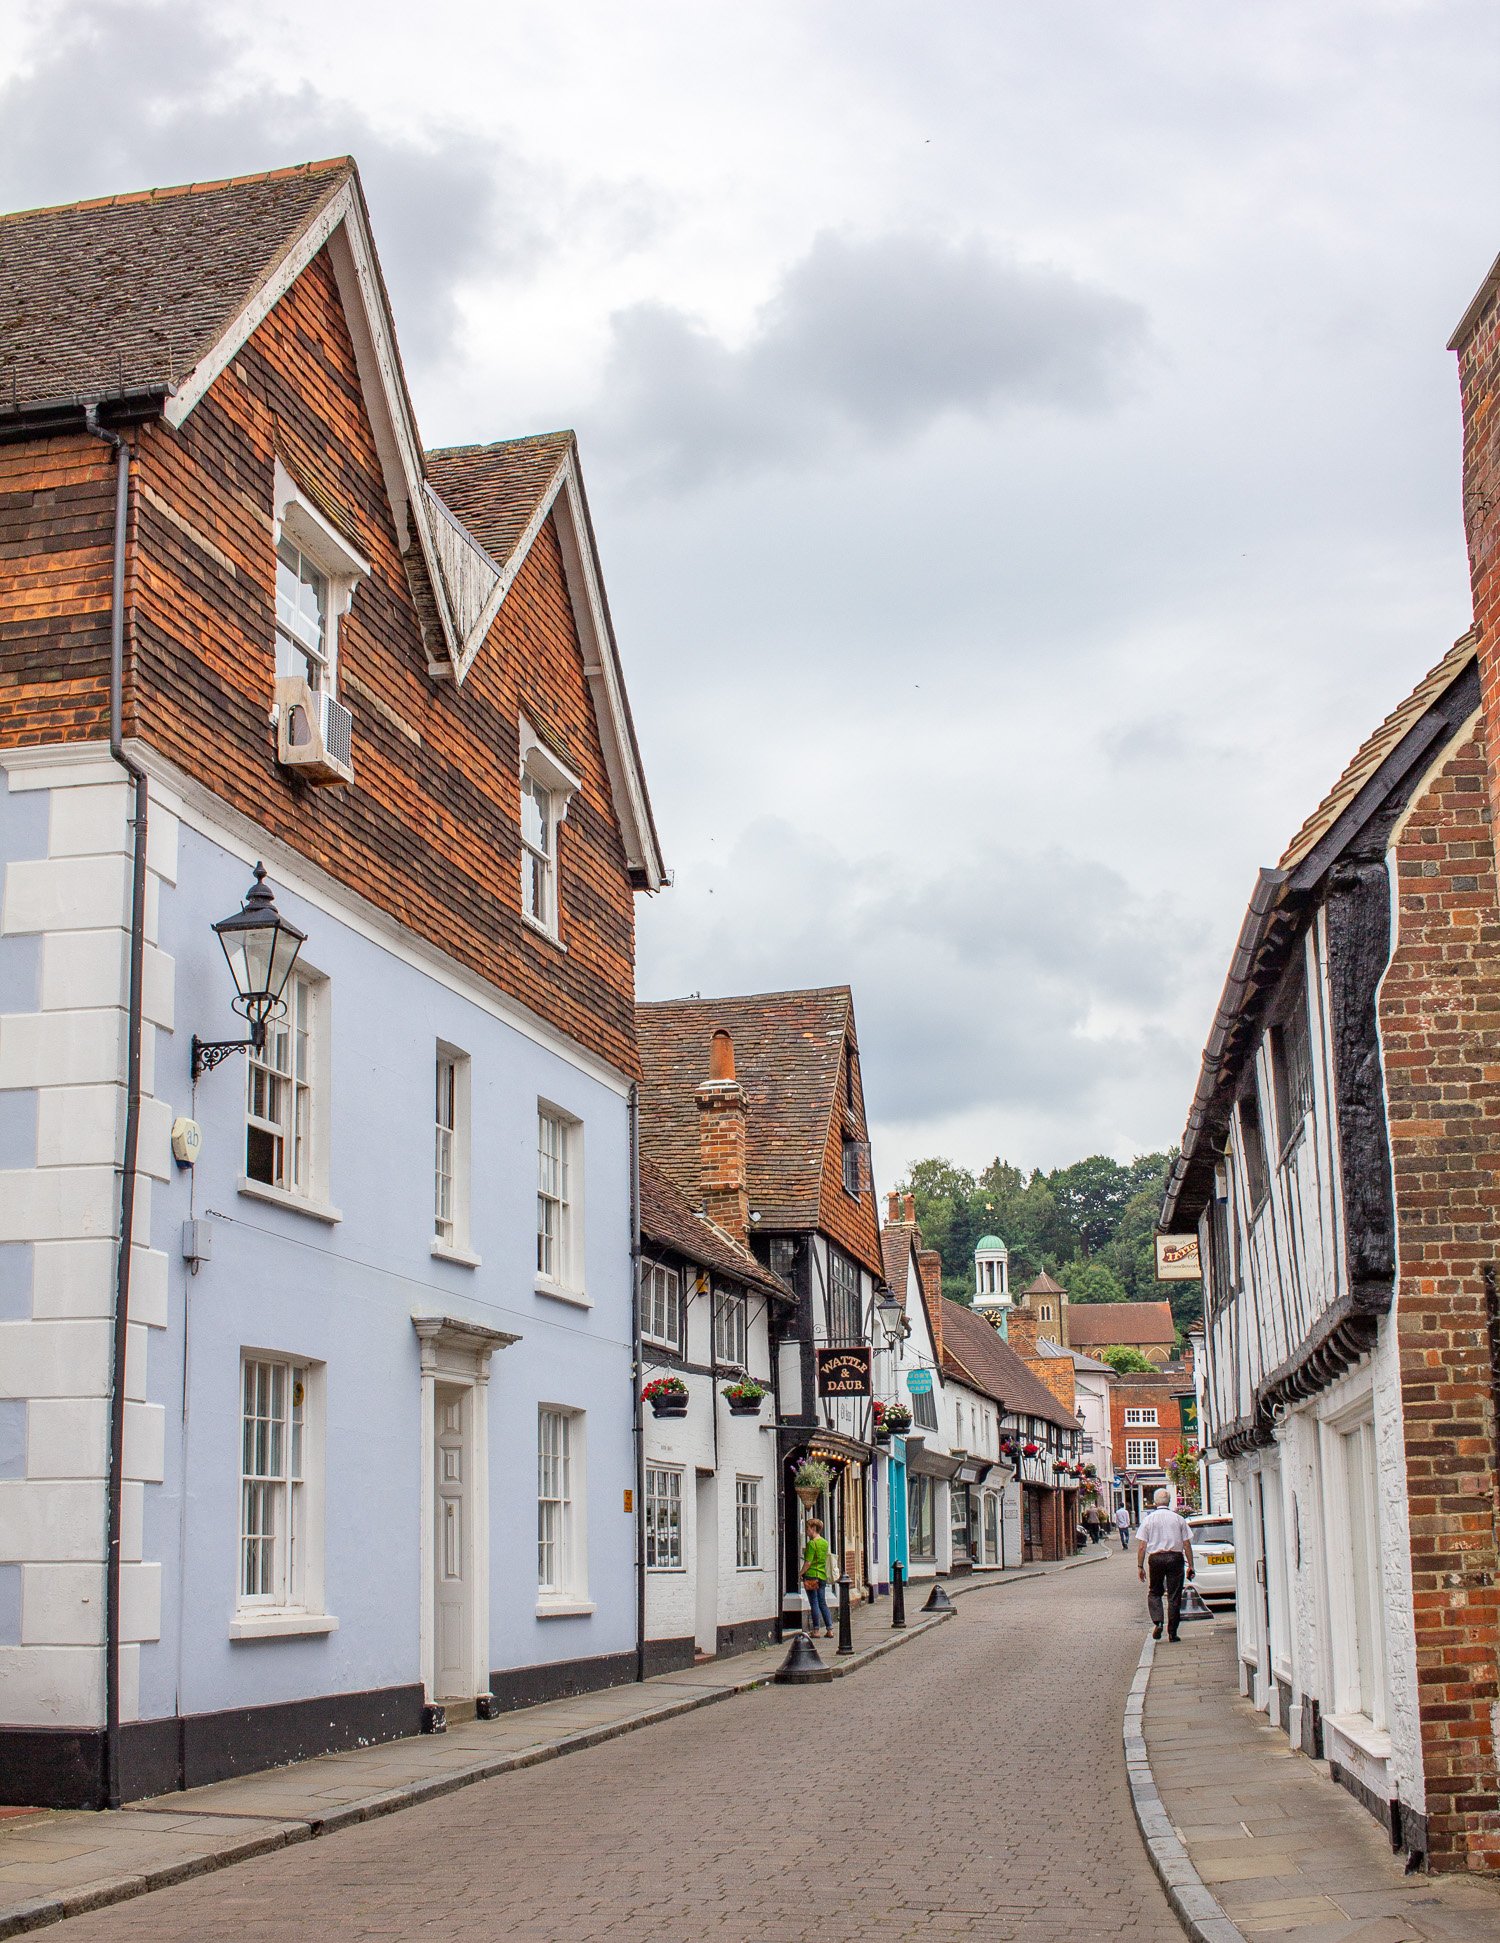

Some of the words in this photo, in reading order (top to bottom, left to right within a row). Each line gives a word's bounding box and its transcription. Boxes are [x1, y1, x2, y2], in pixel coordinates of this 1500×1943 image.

[187, 1126, 199, 1147] ab
[1166, 1243, 1198, 1261] TATTO
[820, 1355, 868, 1374] WATTLE
[840, 1368, 850, 1378] &
[827, 1380, 865, 1391] DAUB.
